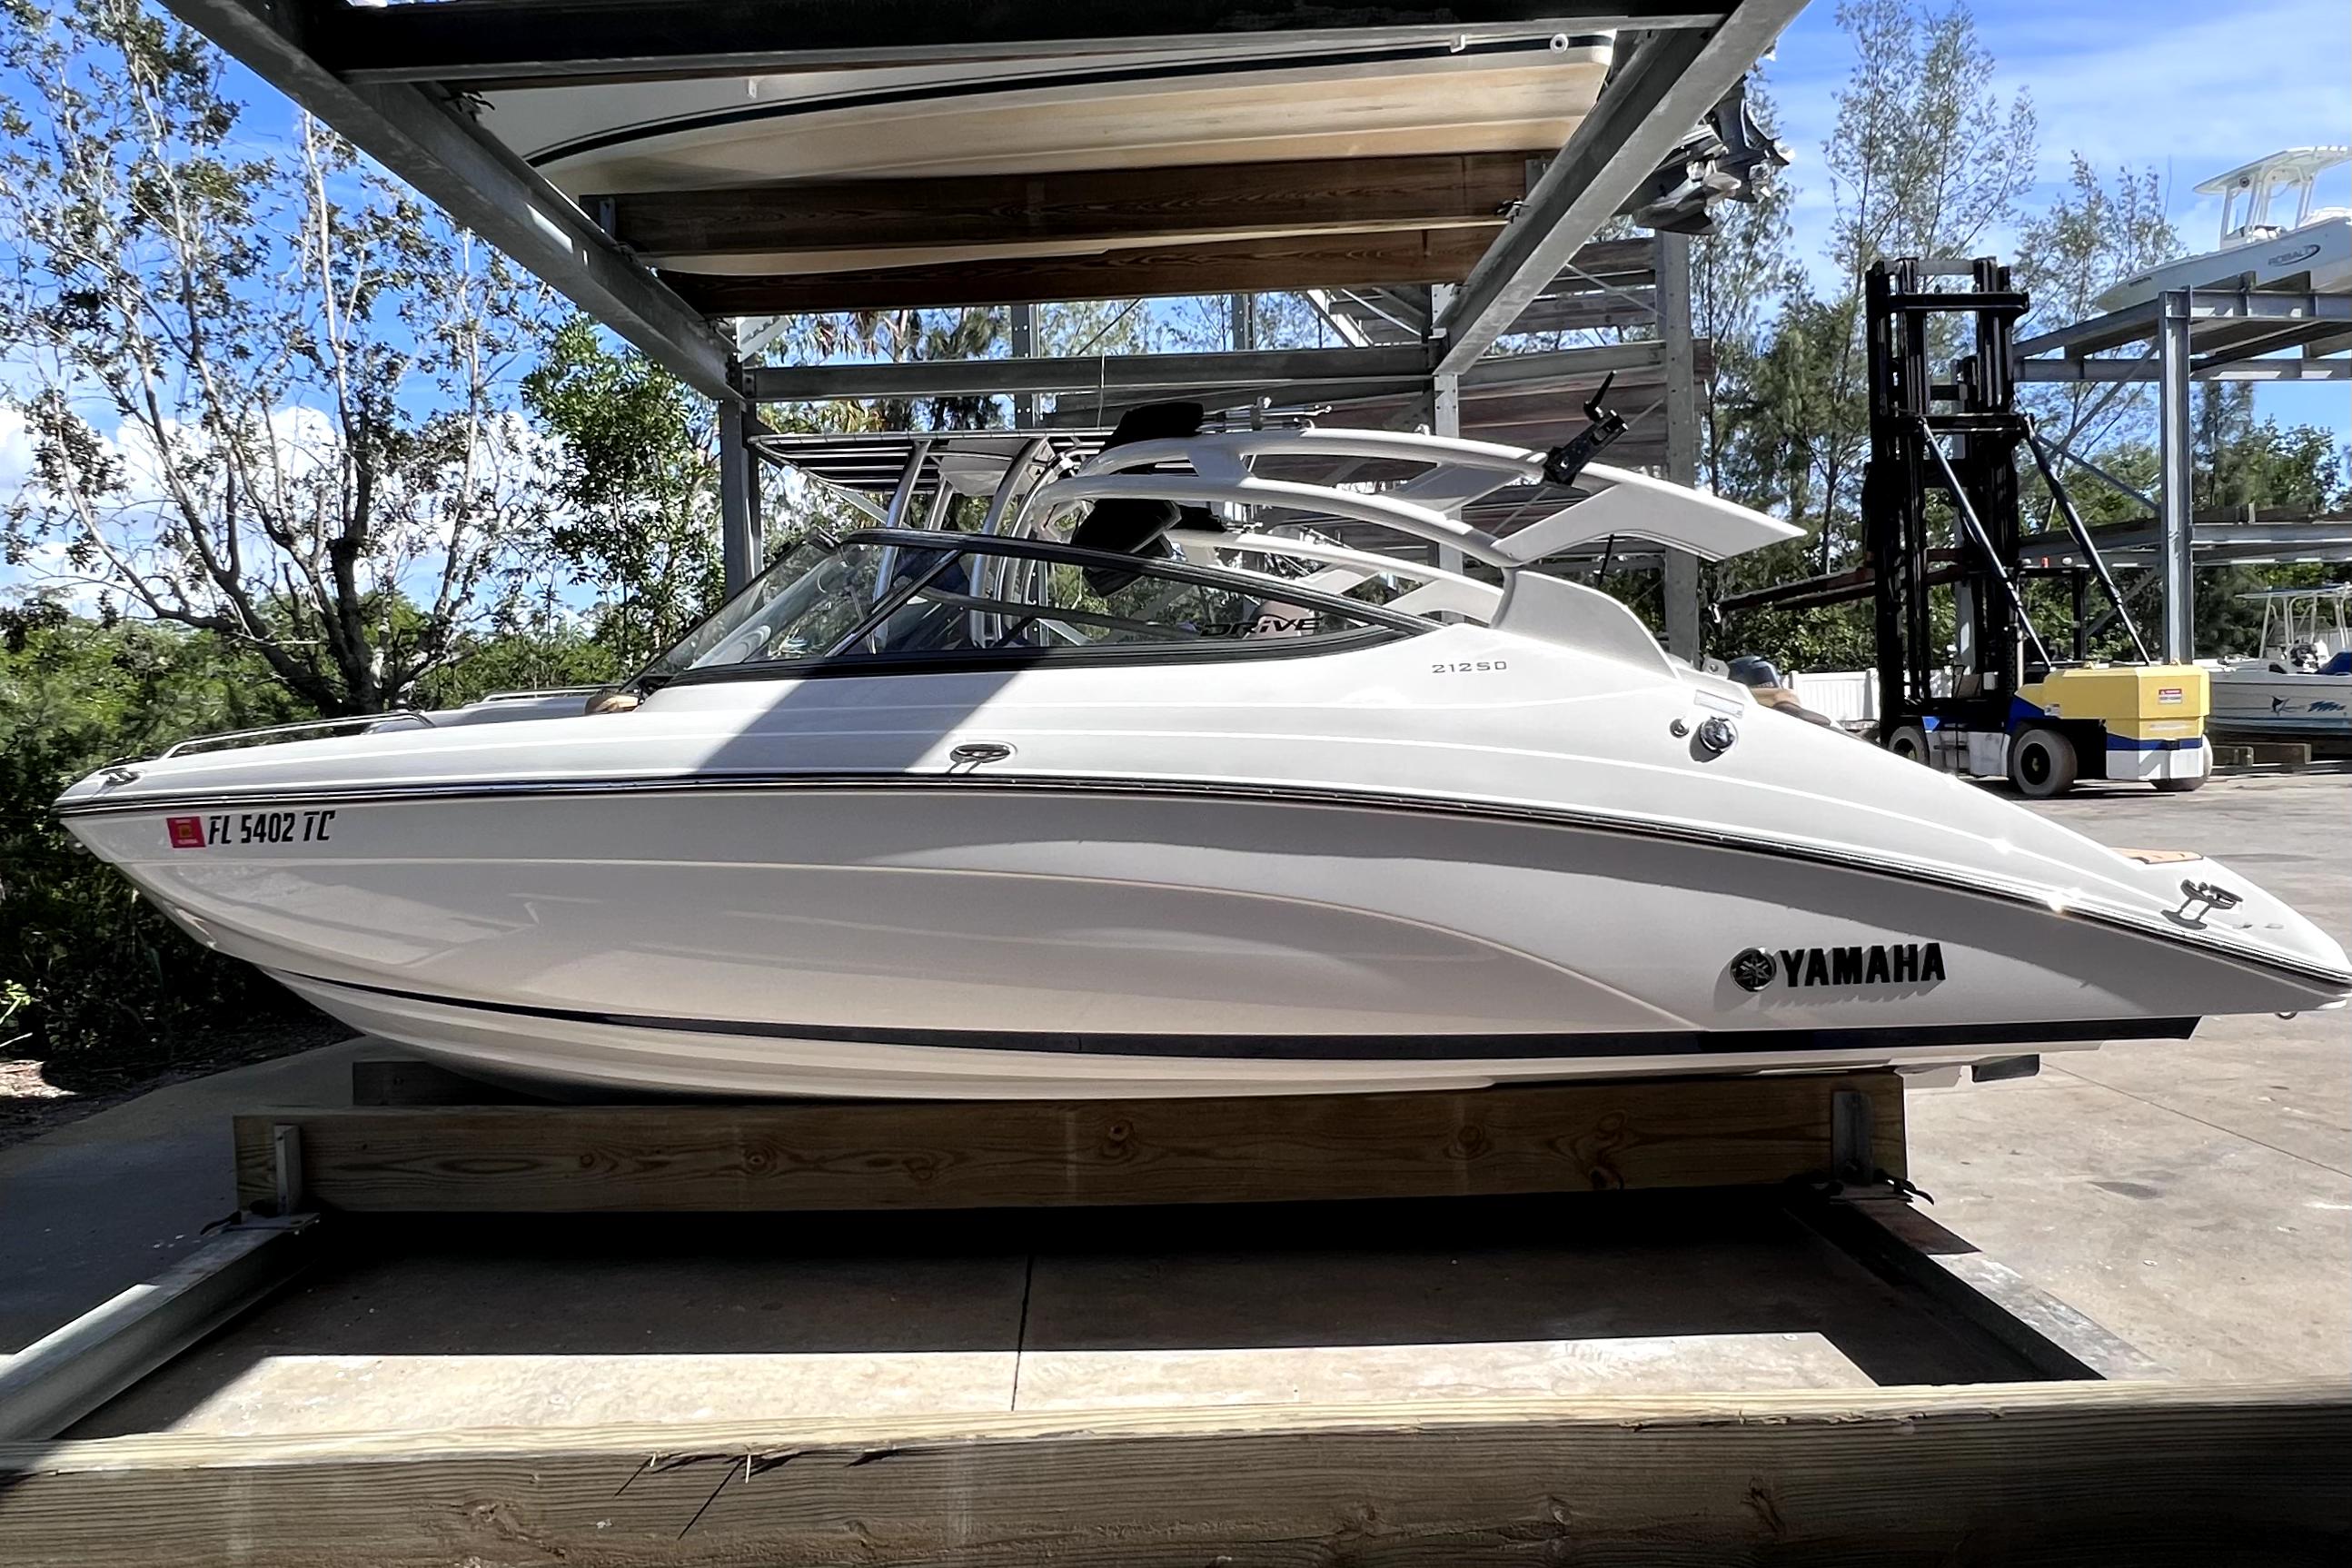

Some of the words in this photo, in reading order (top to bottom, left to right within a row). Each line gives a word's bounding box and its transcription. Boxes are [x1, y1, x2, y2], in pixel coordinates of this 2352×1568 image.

[1432, 661, 1507, 673] 212SD
[208, 815, 232, 844] FL
[241, 812, 295, 843] 5402
[303, 809, 336, 841] TC
[1780, 942, 1946, 987] YAMAHA
